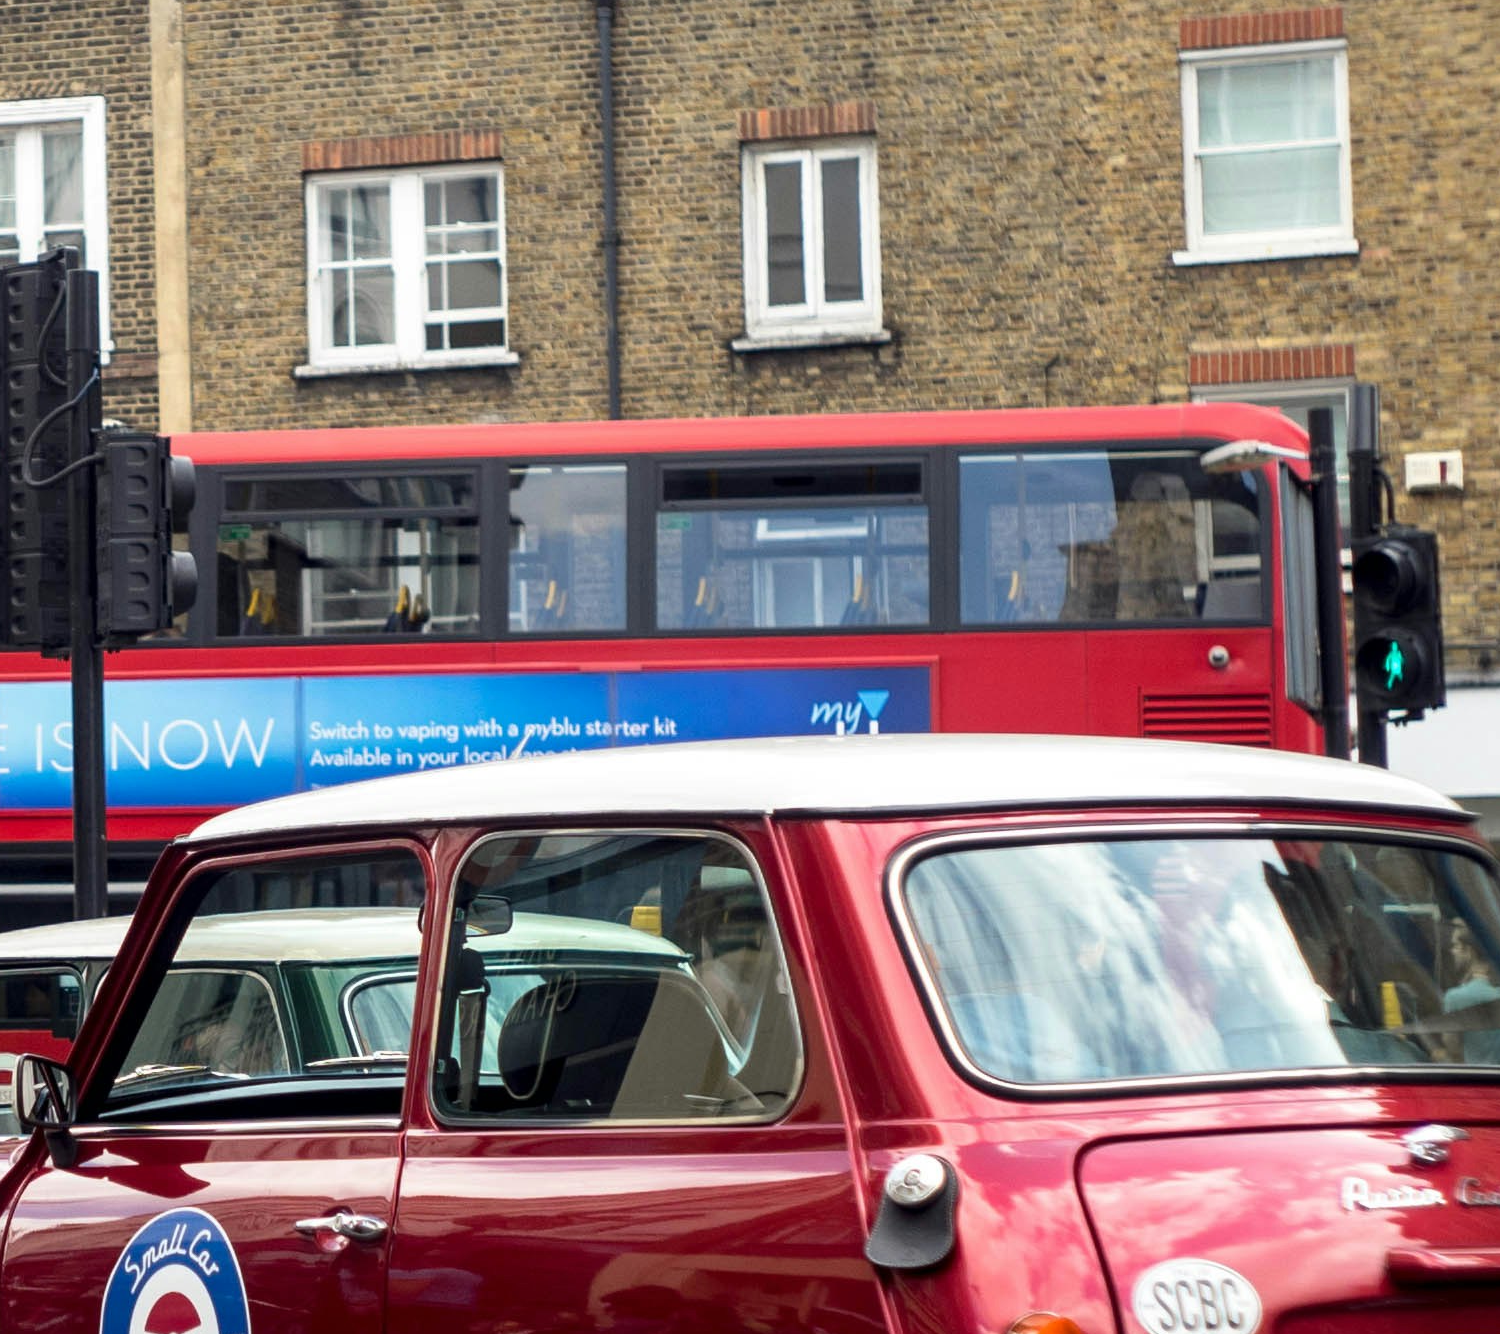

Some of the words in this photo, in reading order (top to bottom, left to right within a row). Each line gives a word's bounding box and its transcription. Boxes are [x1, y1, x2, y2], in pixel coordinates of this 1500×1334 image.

[36, 721, 73, 772] IS
[111, 717, 275, 771] NOW
[310, 721, 369, 740] Switch
[374, 723, 393, 739] to
[395, 721, 459, 743] vaping
[463, 717, 503, 737] with
[507, 723, 519, 737] a
[524, 716, 580, 741] myblu
[585, 719, 650, 737] starter
[653, 715, 678, 736] kit
[310, 746, 392, 766] Available
[396, 748, 413, 765] in
[417, 751, 460, 770] your
[463, 745, 507, 764] local
[124, 1223, 187, 1295] Small
[189, 1229, 220, 1277] Car
[1152, 1278, 1248, 1332] SCBC
